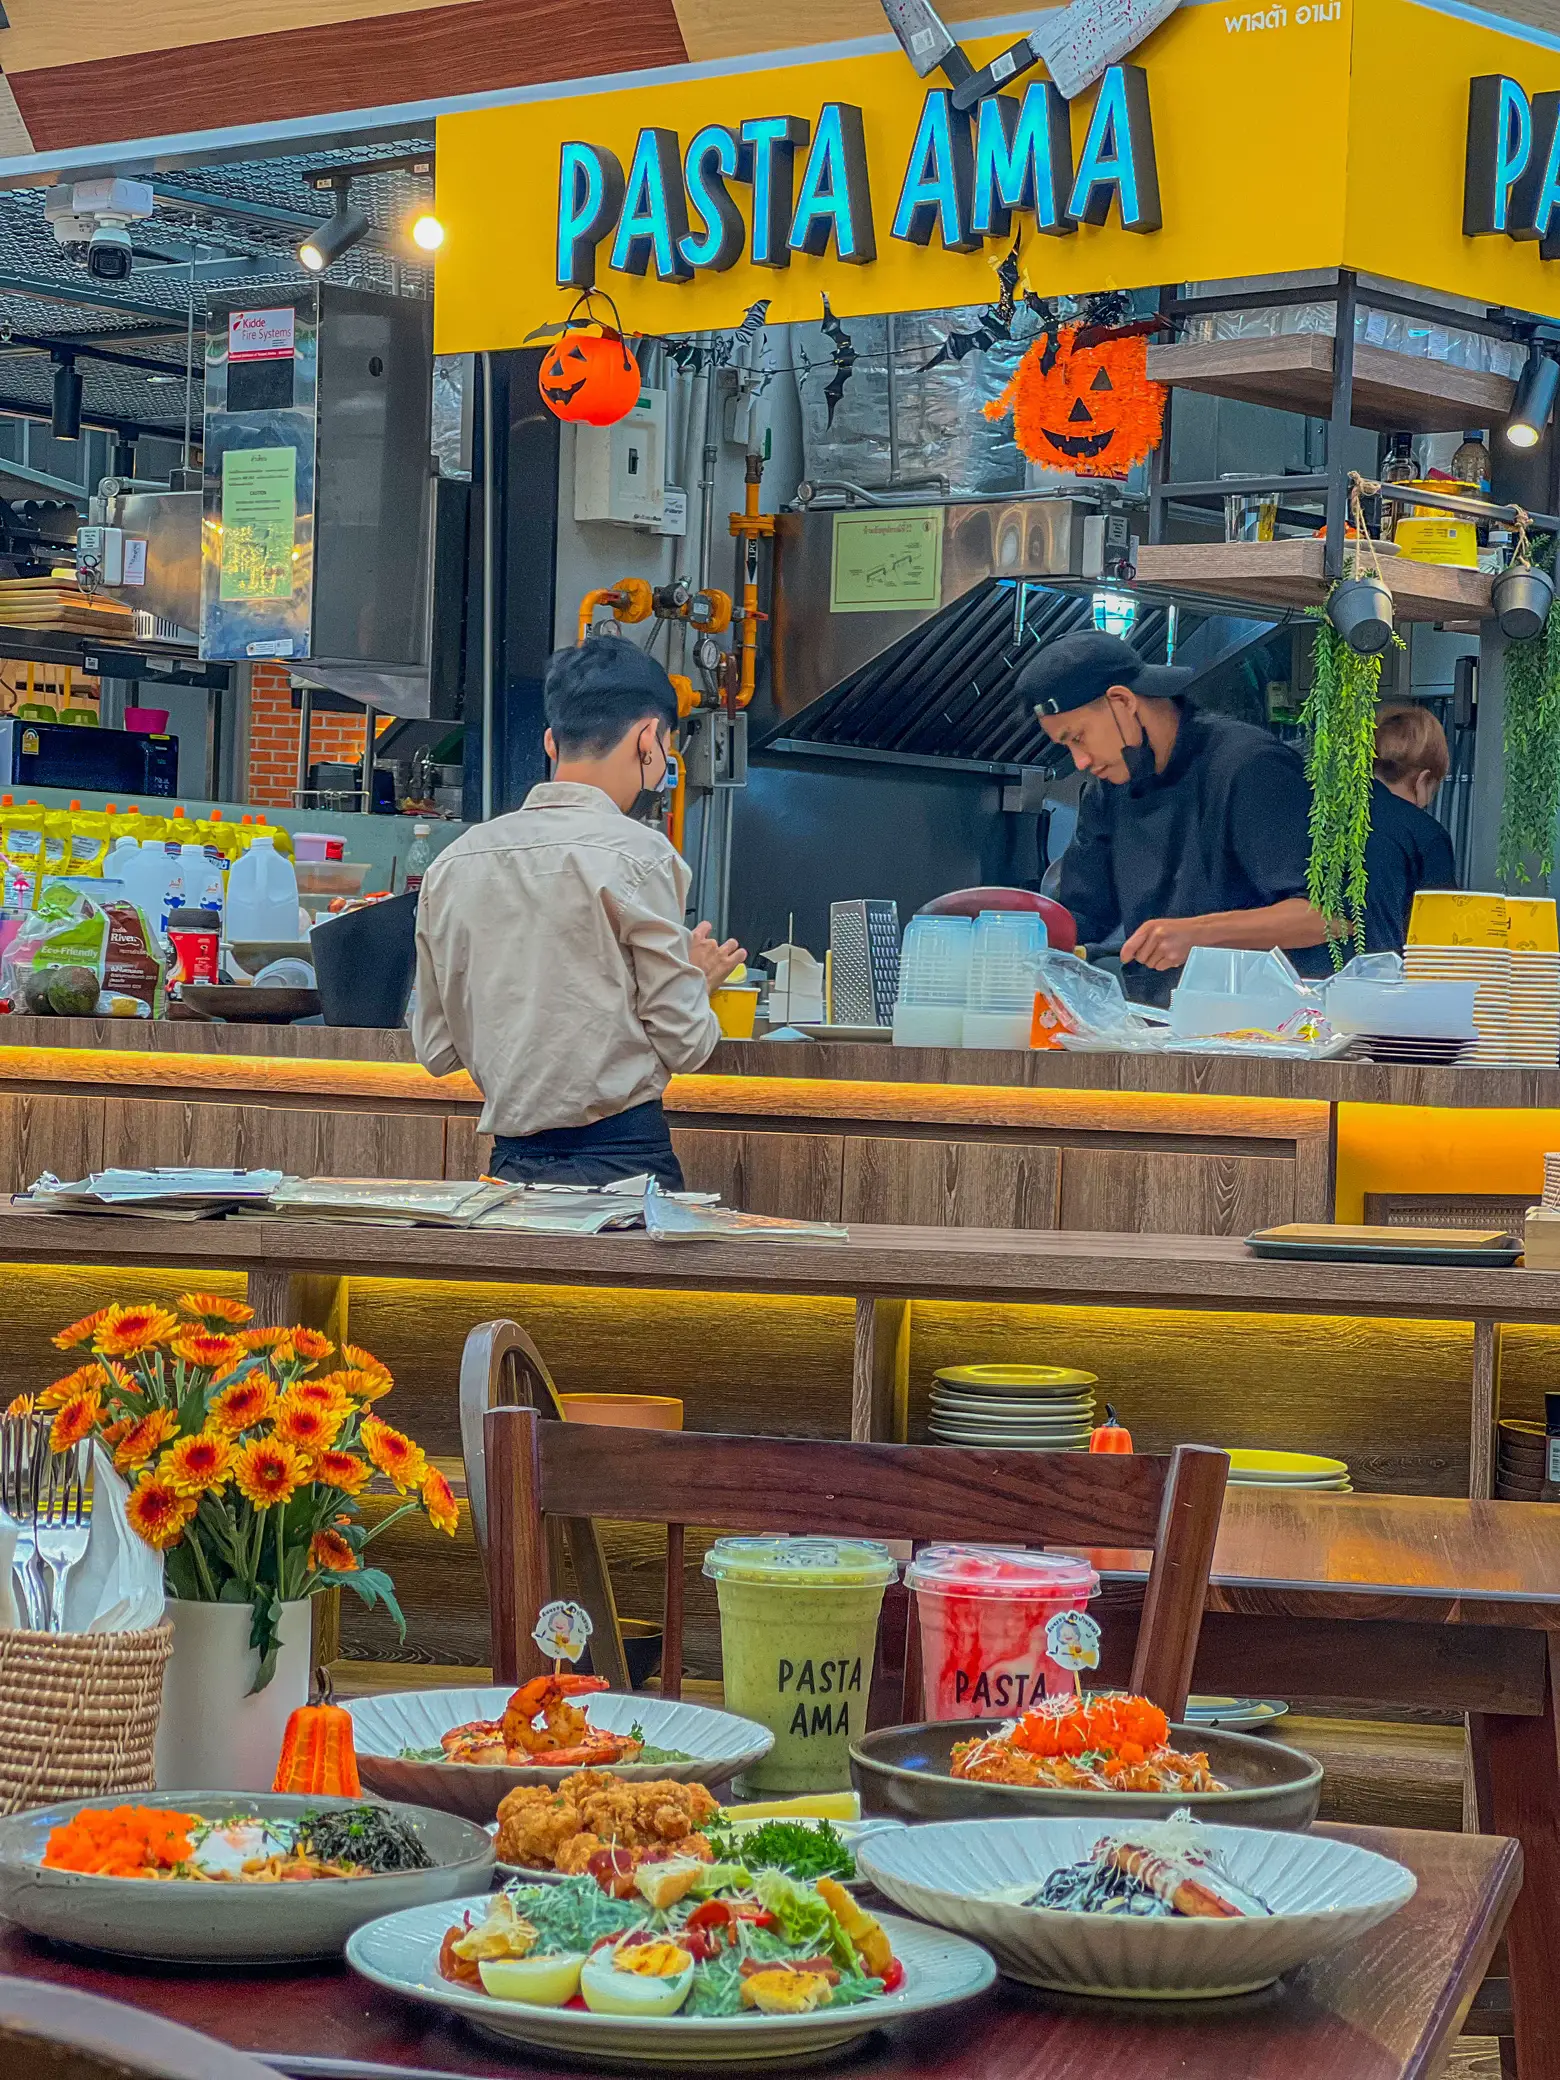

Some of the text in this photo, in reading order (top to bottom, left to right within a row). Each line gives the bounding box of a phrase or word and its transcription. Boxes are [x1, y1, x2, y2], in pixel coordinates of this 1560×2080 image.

[556, 62, 1158, 287] PASTA AMA
[242, 318, 266, 329] Kidde
[242, 328, 292, 341] Fire Systems
[748, 540, 756, 558] LPG
[41, 945, 99, 958] Eco-Friendly
[778, 1657, 861, 1695] PASTA
[956, 1670, 1046, 1708] PASTA
[789, 1702, 849, 1738] AMA
